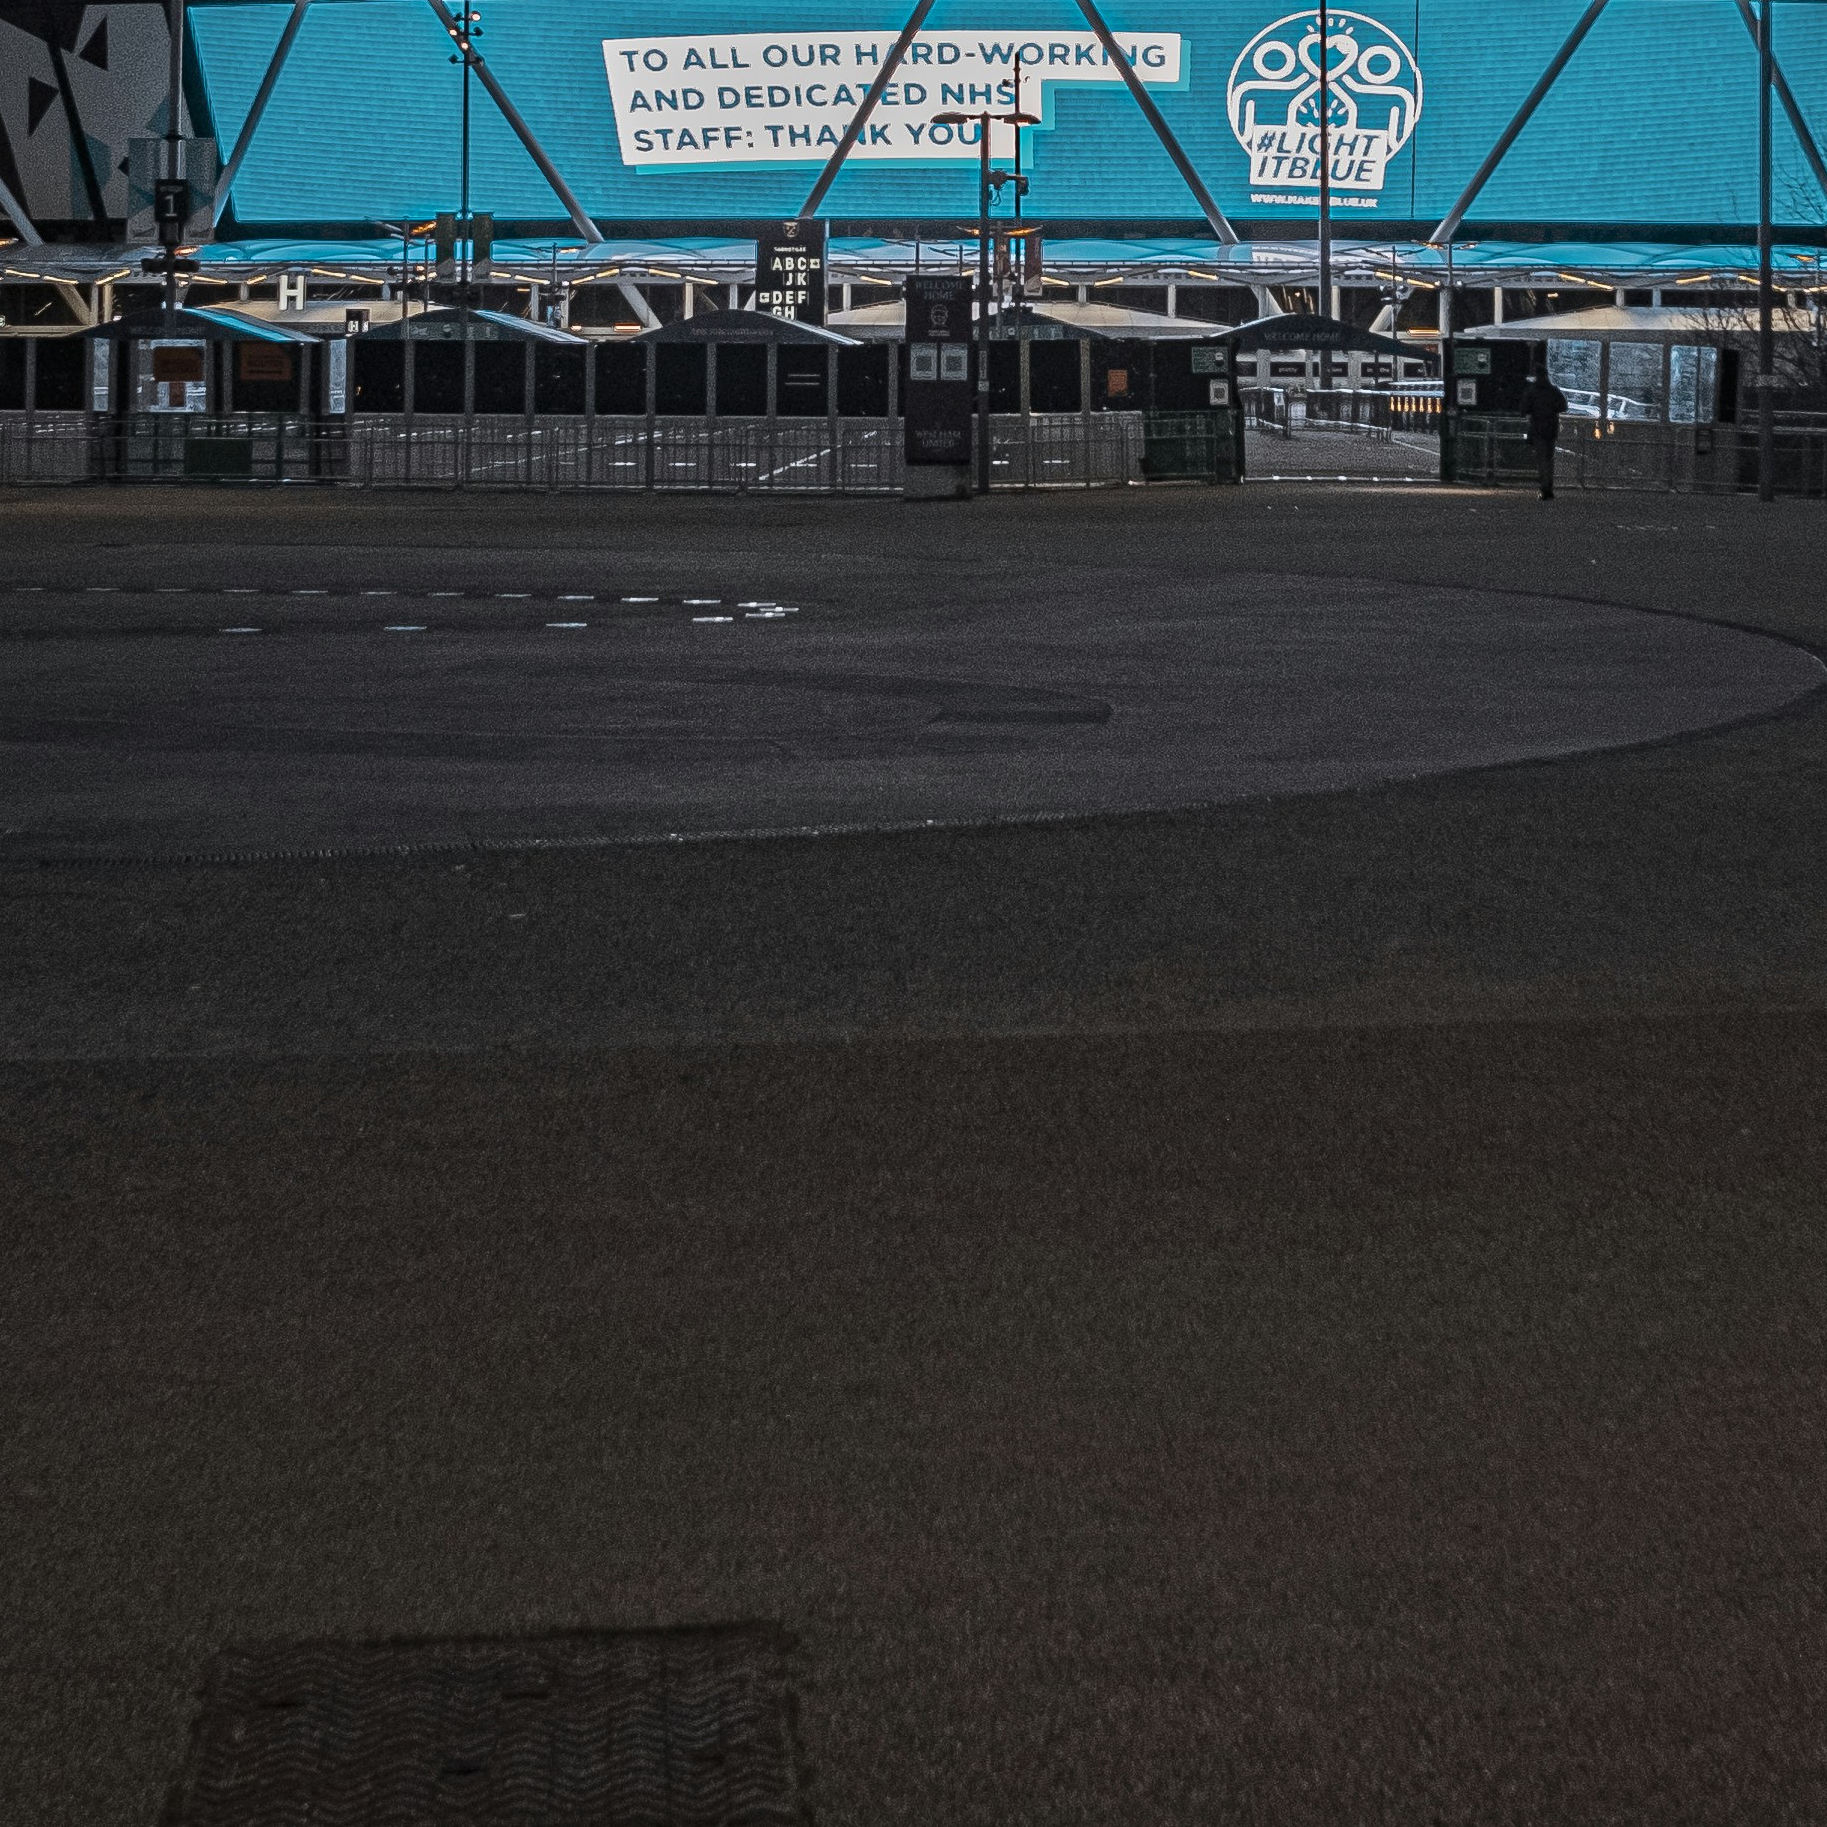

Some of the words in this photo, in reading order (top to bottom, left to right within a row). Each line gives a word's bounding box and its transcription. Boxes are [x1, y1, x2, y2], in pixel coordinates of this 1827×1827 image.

[620, 49, 668, 72] TO
[683, 47, 750, 70] ALL
[762, 44, 841, 67] OUR
[630, 88, 704, 113] AND
[718, 82, 927, 109] DEDICATED
[941, 83, 1016, 105] NHS
[634, 126, 753, 152] STAFF:
[764, 124, 892, 148] THANK
[905, 123, 982, 145] YOU
[1257, 131, 1379, 157] #LIGHT
[1258, 156, 1376, 182] ITBLUE
[165, 195, 178, 217] 1
[278, 275, 307, 311] H
